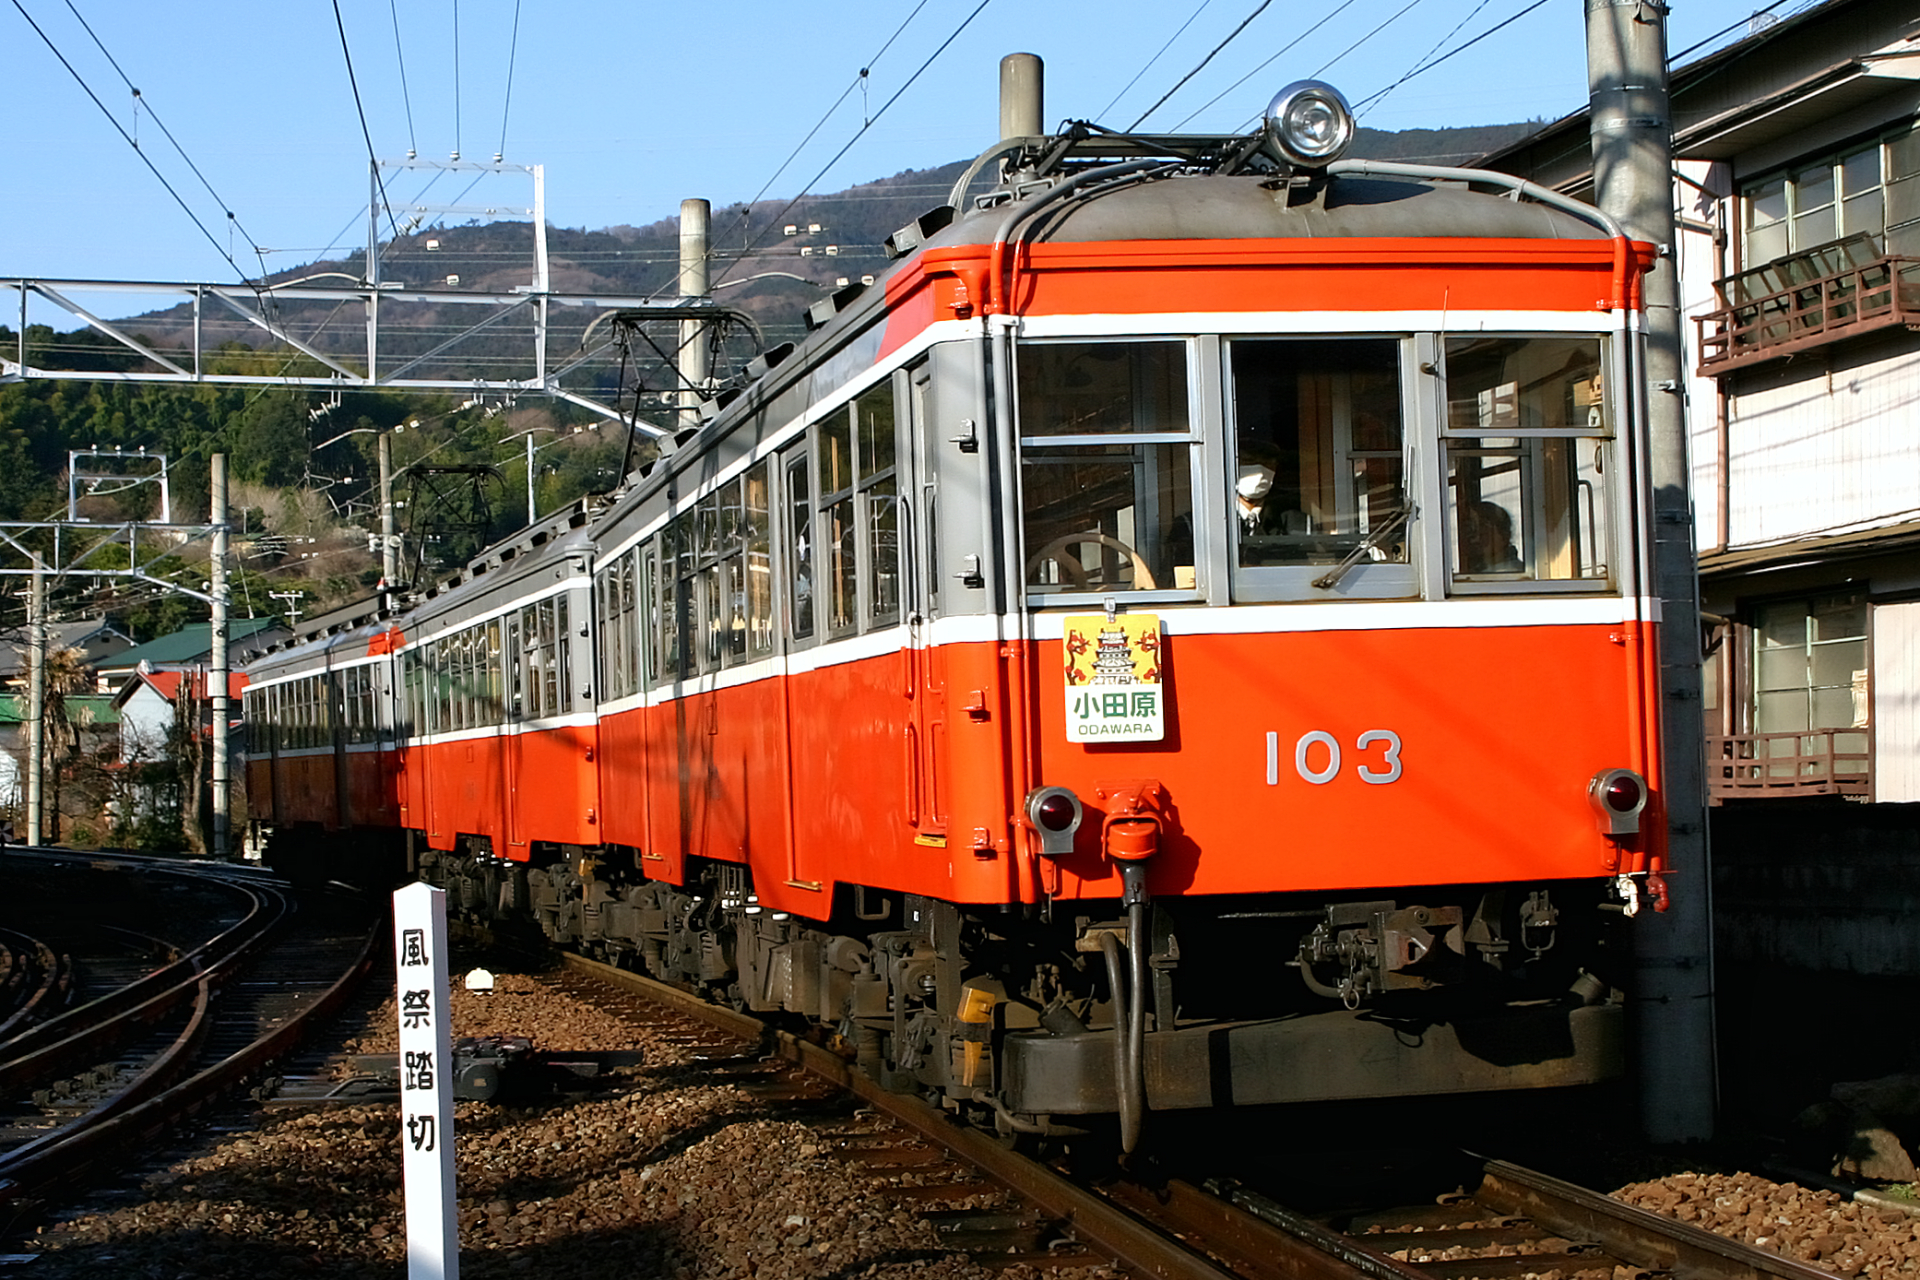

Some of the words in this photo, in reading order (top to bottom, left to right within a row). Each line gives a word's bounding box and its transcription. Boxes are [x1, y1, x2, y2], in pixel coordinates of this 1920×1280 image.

[1073, 691, 1157, 719] 小田原
[1078, 724, 1153, 735] ODAWARA
[1266, 729, 1402, 785] 103
[401, 928, 435, 1152] 風祭踏切
